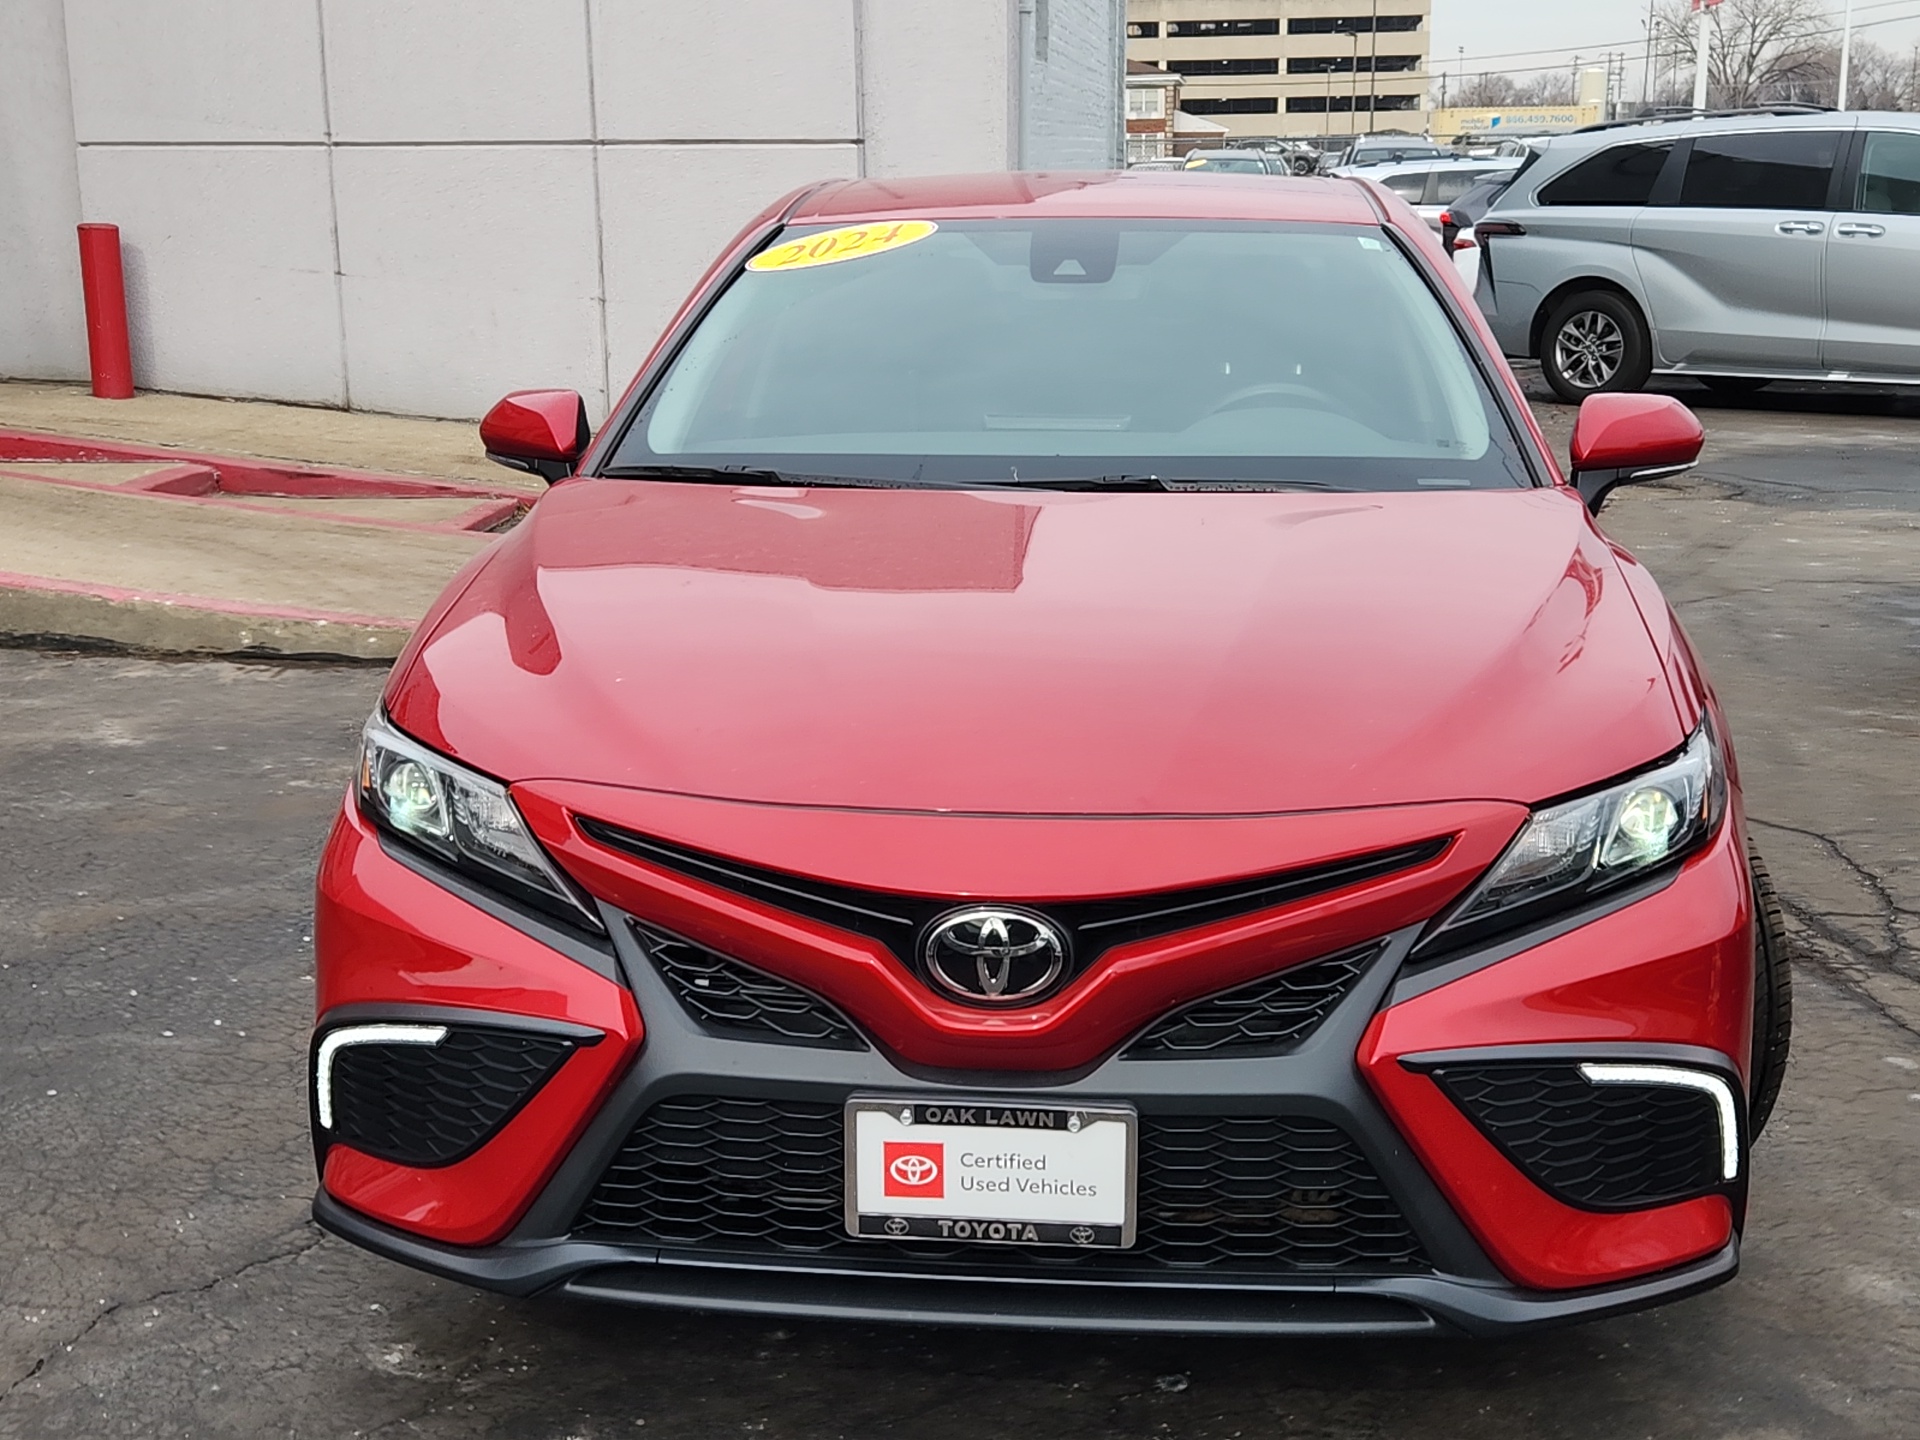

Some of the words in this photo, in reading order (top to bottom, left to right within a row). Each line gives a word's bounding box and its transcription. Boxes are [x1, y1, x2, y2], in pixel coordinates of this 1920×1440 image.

[776, 224, 903, 266] 2024
[925, 1106, 976, 1125] OAK
[985, 1109, 1054, 1128] LAWN
[960, 1152, 1046, 1171] Certified
[960, 1176, 1010, 1193] Used
[1016, 1178, 1097, 1197] Vehicles
[937, 1220, 1038, 1241] TOYOTA
